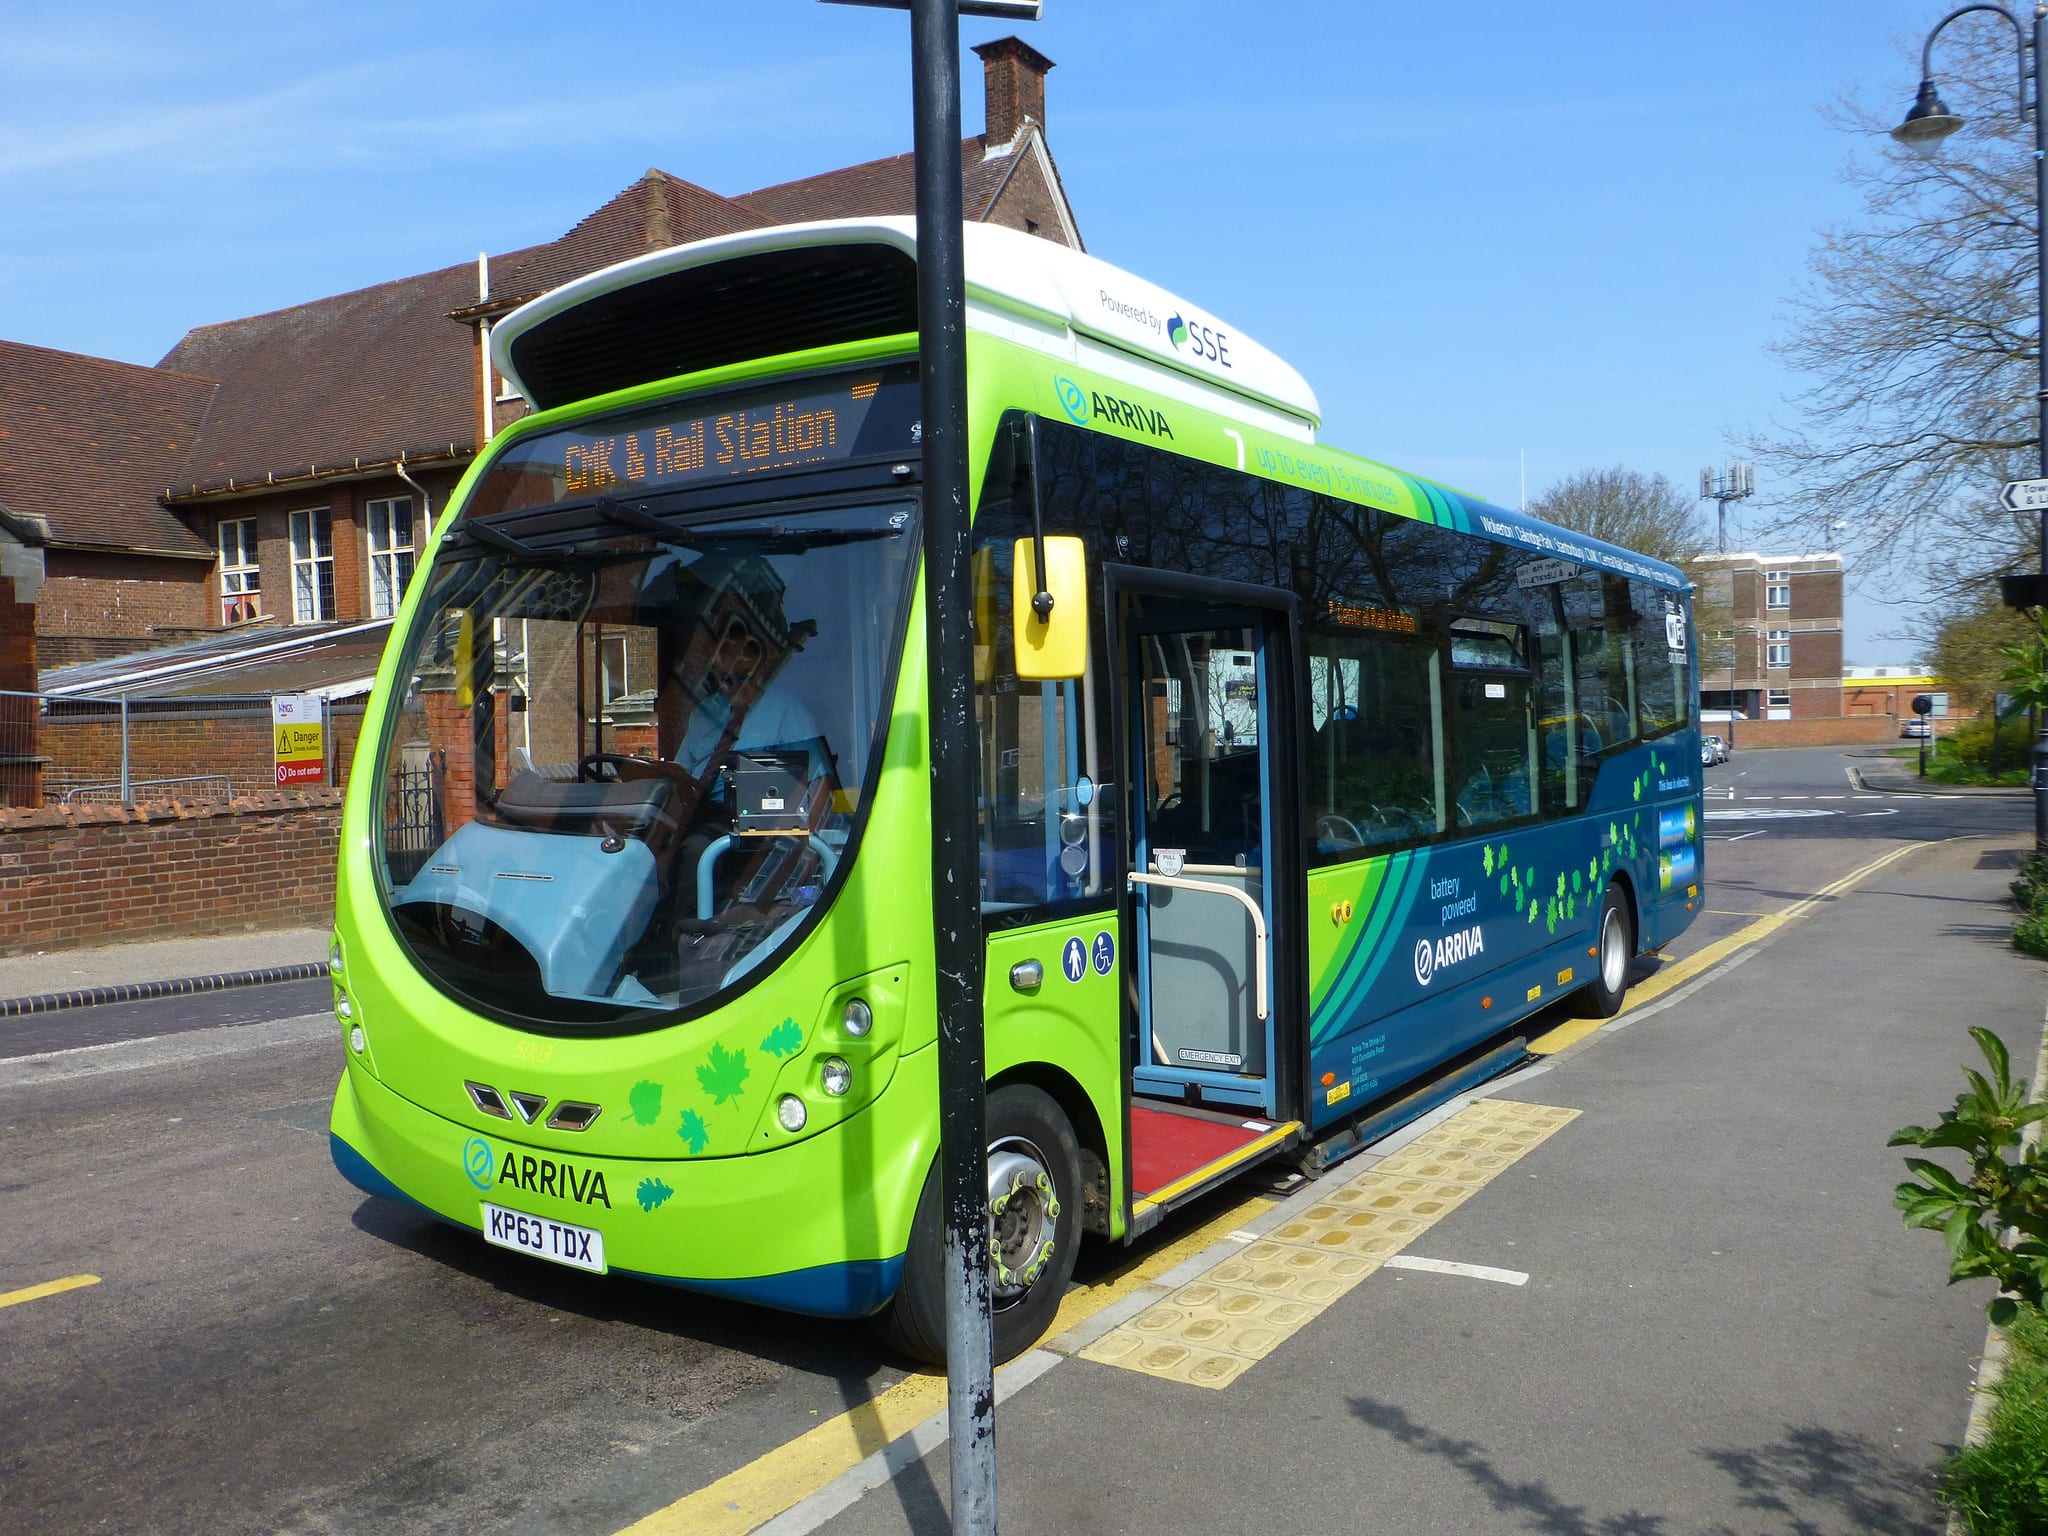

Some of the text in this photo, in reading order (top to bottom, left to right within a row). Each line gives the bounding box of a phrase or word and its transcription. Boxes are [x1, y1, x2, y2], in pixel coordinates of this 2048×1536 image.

[1100, 290, 1162, 335] Powered by
[1189, 320, 1232, 368] SSE
[1093, 391, 1174, 440] ARRIVA
[566, 404, 836, 490] CMK & Rail Station
[1255, 447, 1398, 505] up to every 15 minutes
[294, 731, 319, 743] Danger
[288, 769, 296, 777] Do
[307, 767, 321, 775] enter
[1430, 877, 1460, 900] battery
[1441, 890, 1476, 927] powered
[1434, 925, 1484, 971] ARRIVA
[1180, 1051, 1240, 1064] EMERGENCY EXIT
[498, 1152, 612, 1209] ARRIVA
[491, 1208, 592, 1263] KP63 TDX
